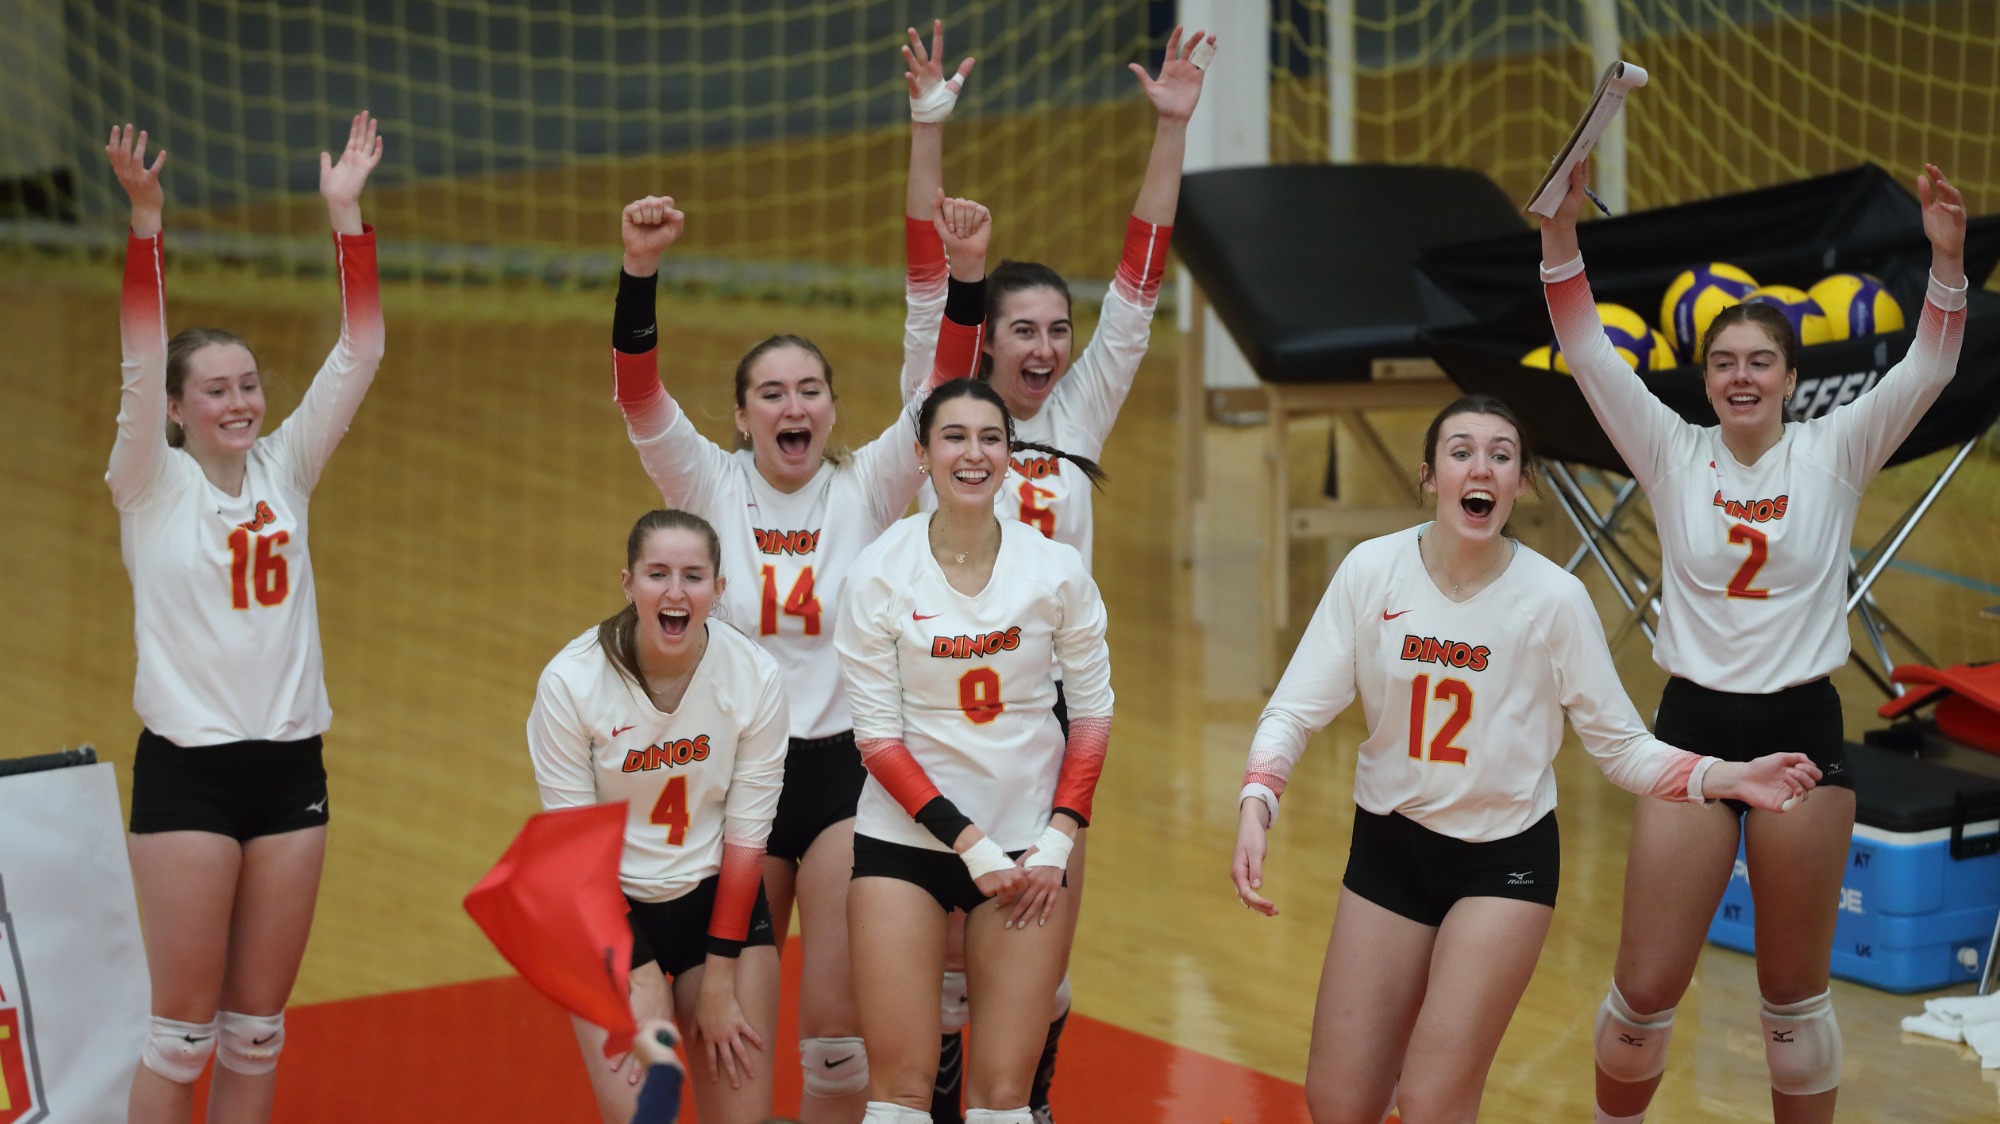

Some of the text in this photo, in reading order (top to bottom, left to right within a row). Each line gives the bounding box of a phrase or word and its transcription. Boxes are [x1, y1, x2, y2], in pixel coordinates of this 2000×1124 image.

[1017, 479, 1057, 540] 6
[227, 527, 290, 610] 16
[1726, 522, 1770, 600] 2
[760, 564, 823, 637] 14
[931, 626, 1022, 658] DINOS
[1400, 634, 1491, 672] DINOS
[622, 734, 711, 773] DINOS
[1407, 672, 1474, 766] 12
[648, 772, 690, 847] 4
